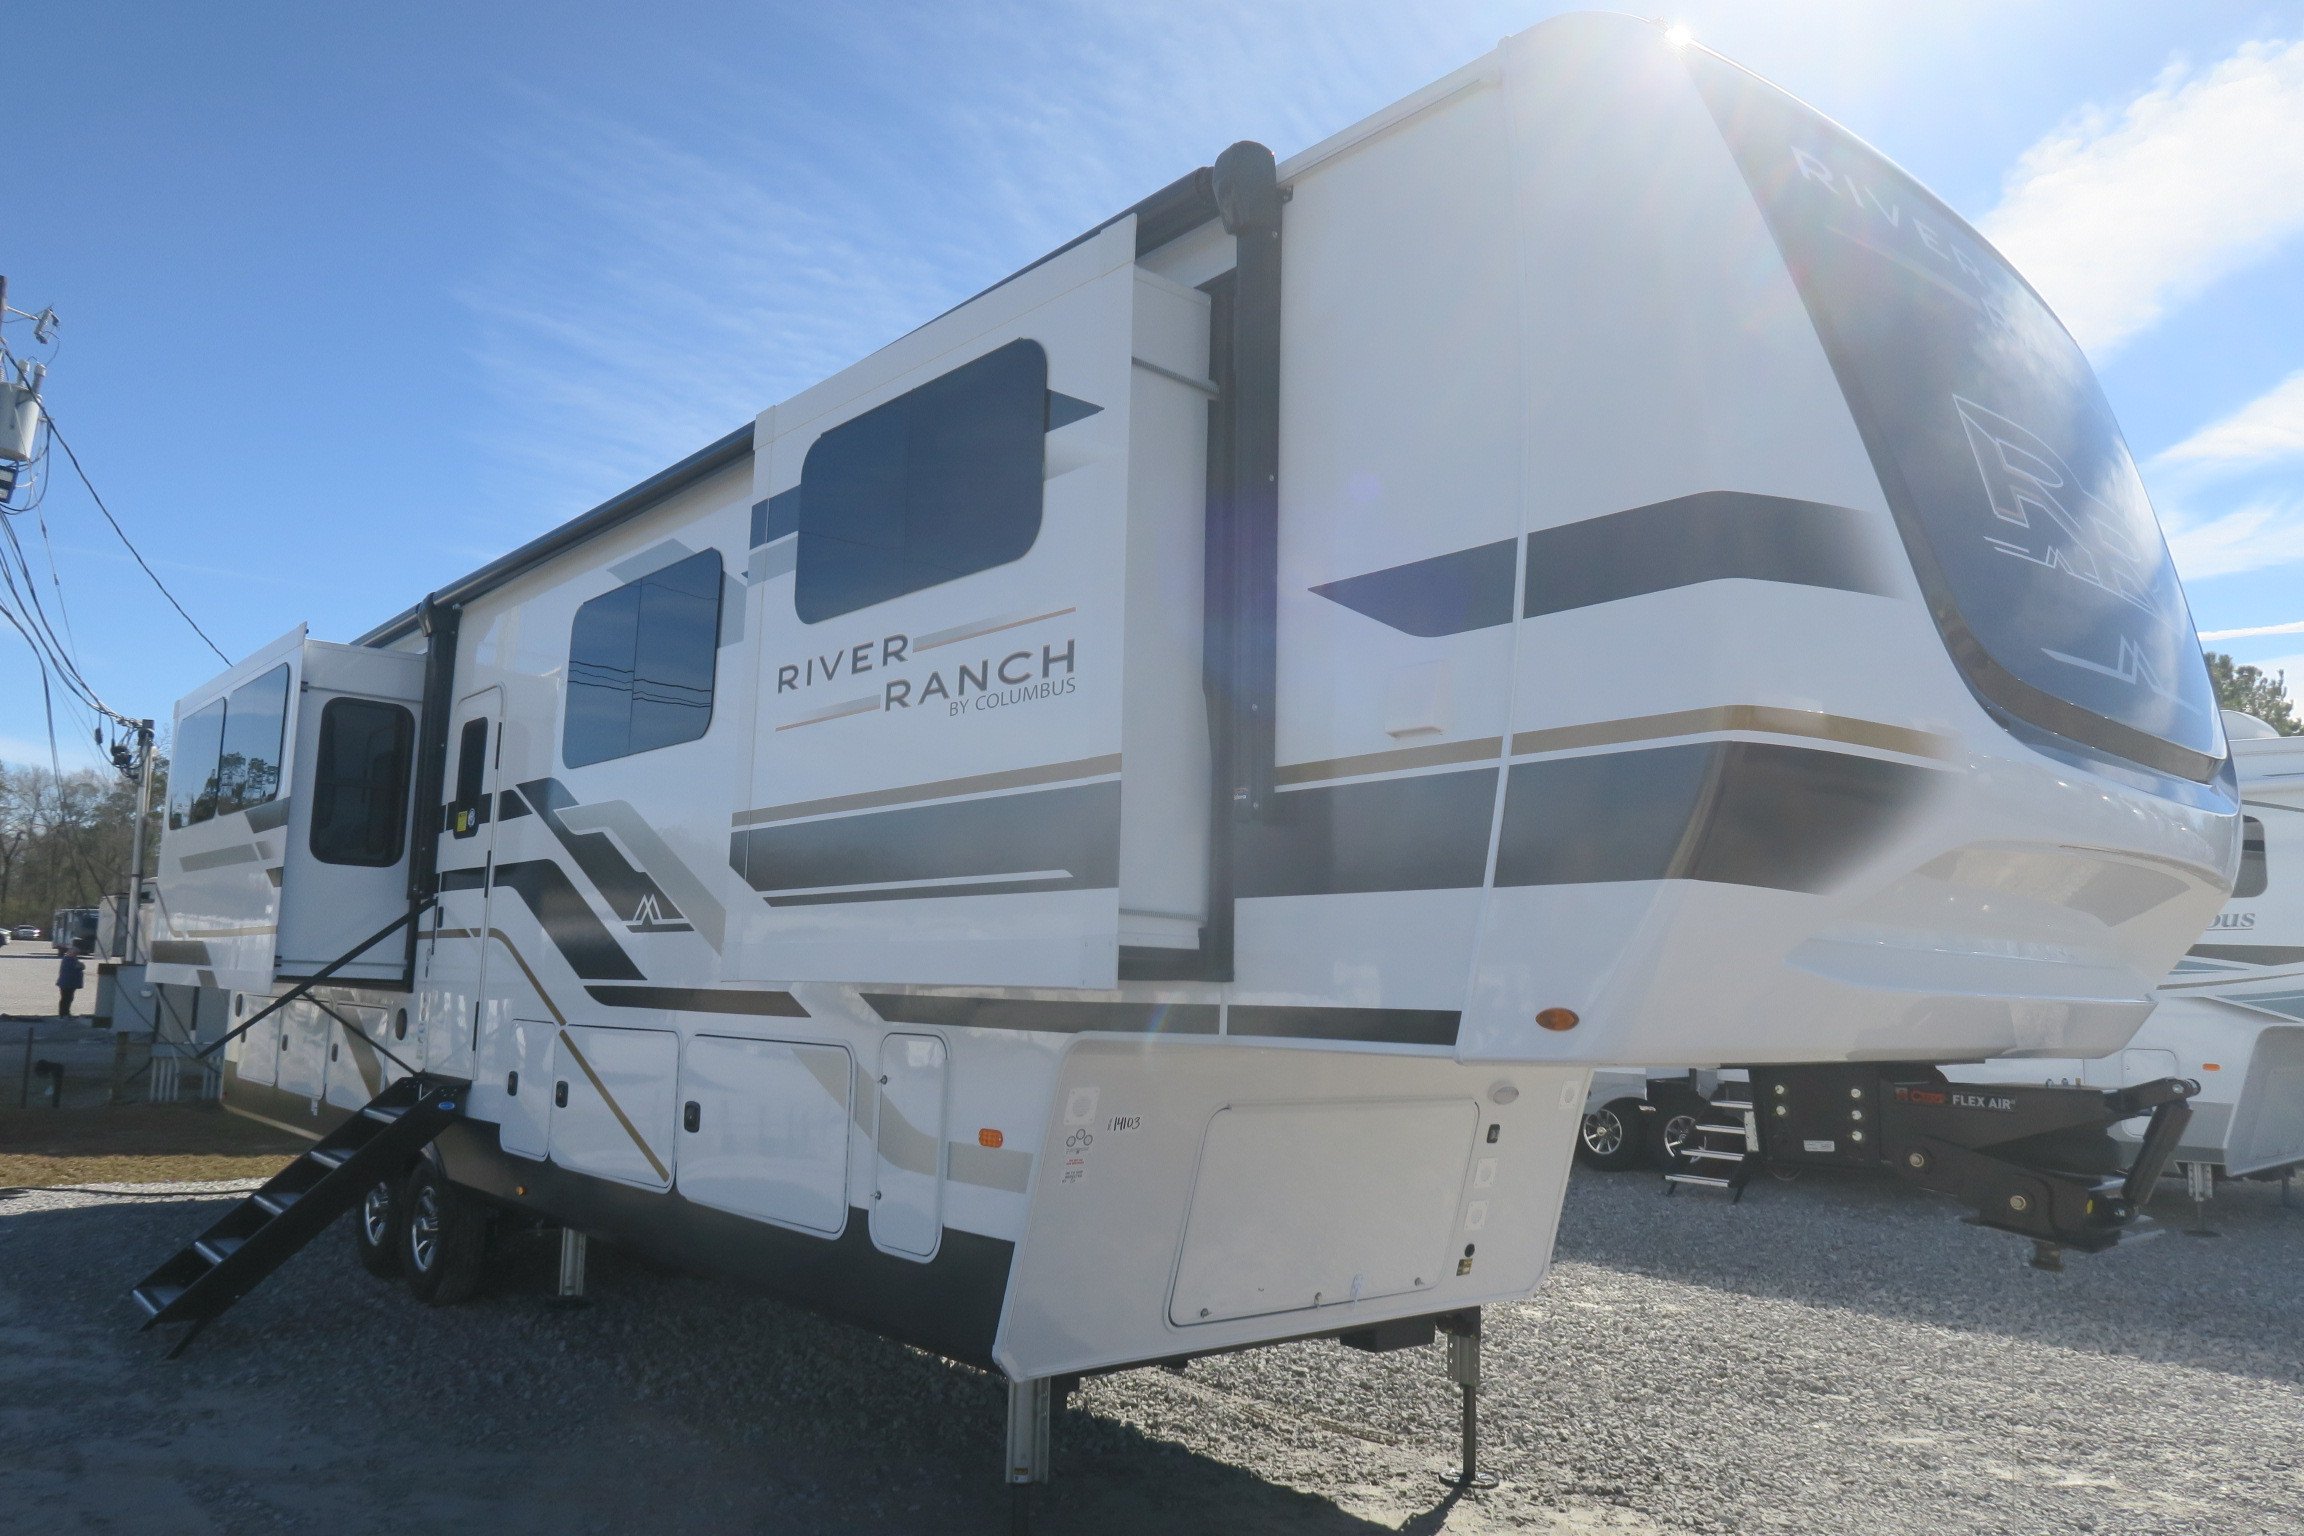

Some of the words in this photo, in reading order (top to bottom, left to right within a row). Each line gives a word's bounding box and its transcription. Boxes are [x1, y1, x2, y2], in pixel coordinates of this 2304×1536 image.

[1790, 145, 1988, 288] RIVER
[776, 633, 910, 694] RIVER
[884, 638, 1076, 712] RANCH
[949, 701, 968, 717] BY
[975, 676, 1077, 711] COLUMBUS
[1952, 1093, 1985, 1108] FLEX
